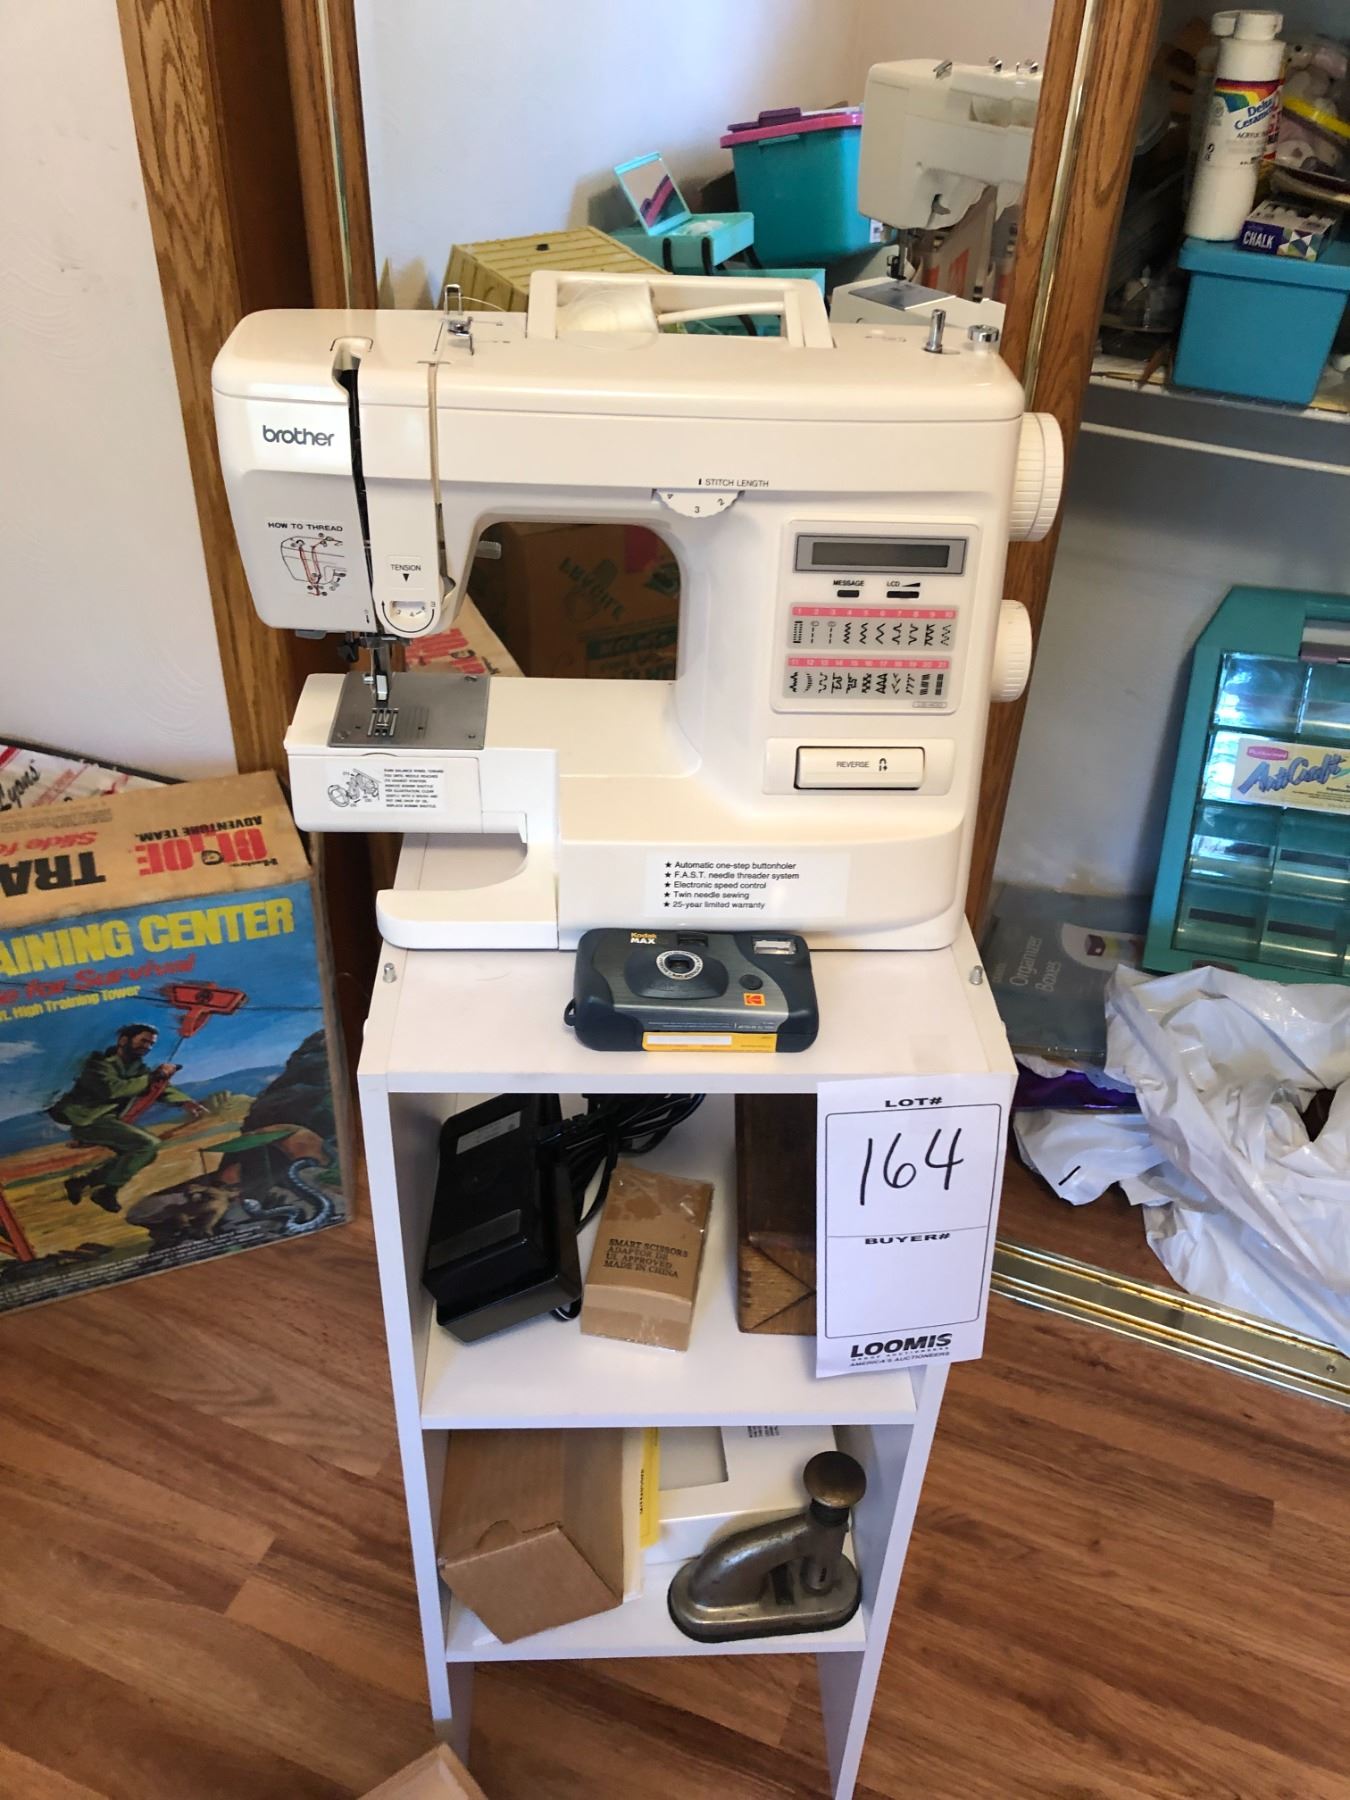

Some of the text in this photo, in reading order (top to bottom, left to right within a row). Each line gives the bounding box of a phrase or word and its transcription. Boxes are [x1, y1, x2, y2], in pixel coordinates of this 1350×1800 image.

[1243, 231, 1275, 249] CHALK
[262, 424, 335, 447] brother
[705, 479, 734, 487] STITCH
[306, 524, 343, 532] THREAD
[390, 564, 421, 572] TENSION
[135, 816, 263, 843] ADVENTURE TEAM.
[26, 832, 98, 851] Slide
[674, 861, 797, 870] Automatic one-step buttonholer
[674, 871, 706, 879] F.A.S.T.
[771, 873, 799, 881] system
[674, 881, 712, 889] Electronic
[714, 882, 738, 890] speed
[672, 901, 702, 909] 25-year
[722, 892, 749, 900] sewing
[138, 898, 295, 953] CENTER
[1009, 935, 1043, 988] Organizer
[25, 977, 68, 999] for
[74, 952, 196, 990] Survival
[1035, 960, 1063, 994] Boxes
[13, 1003, 44, 1019] High
[46, 994, 100, 1013] Training
[101, 985, 141, 1001] Tower
[885, 1096, 943, 1108] LOT#
[860, 1128, 965, 1206] 164
[864, 1232, 950, 1245] BUYER#
[609, 1238, 688, 1258] SMART SCISSORS
[603, 1260, 633, 1269] MADE
[648, 1265, 678, 1278] CHINA
[622, 1255, 673, 1269] APPROVED
[850, 1333, 953, 1358] LOOMIS
